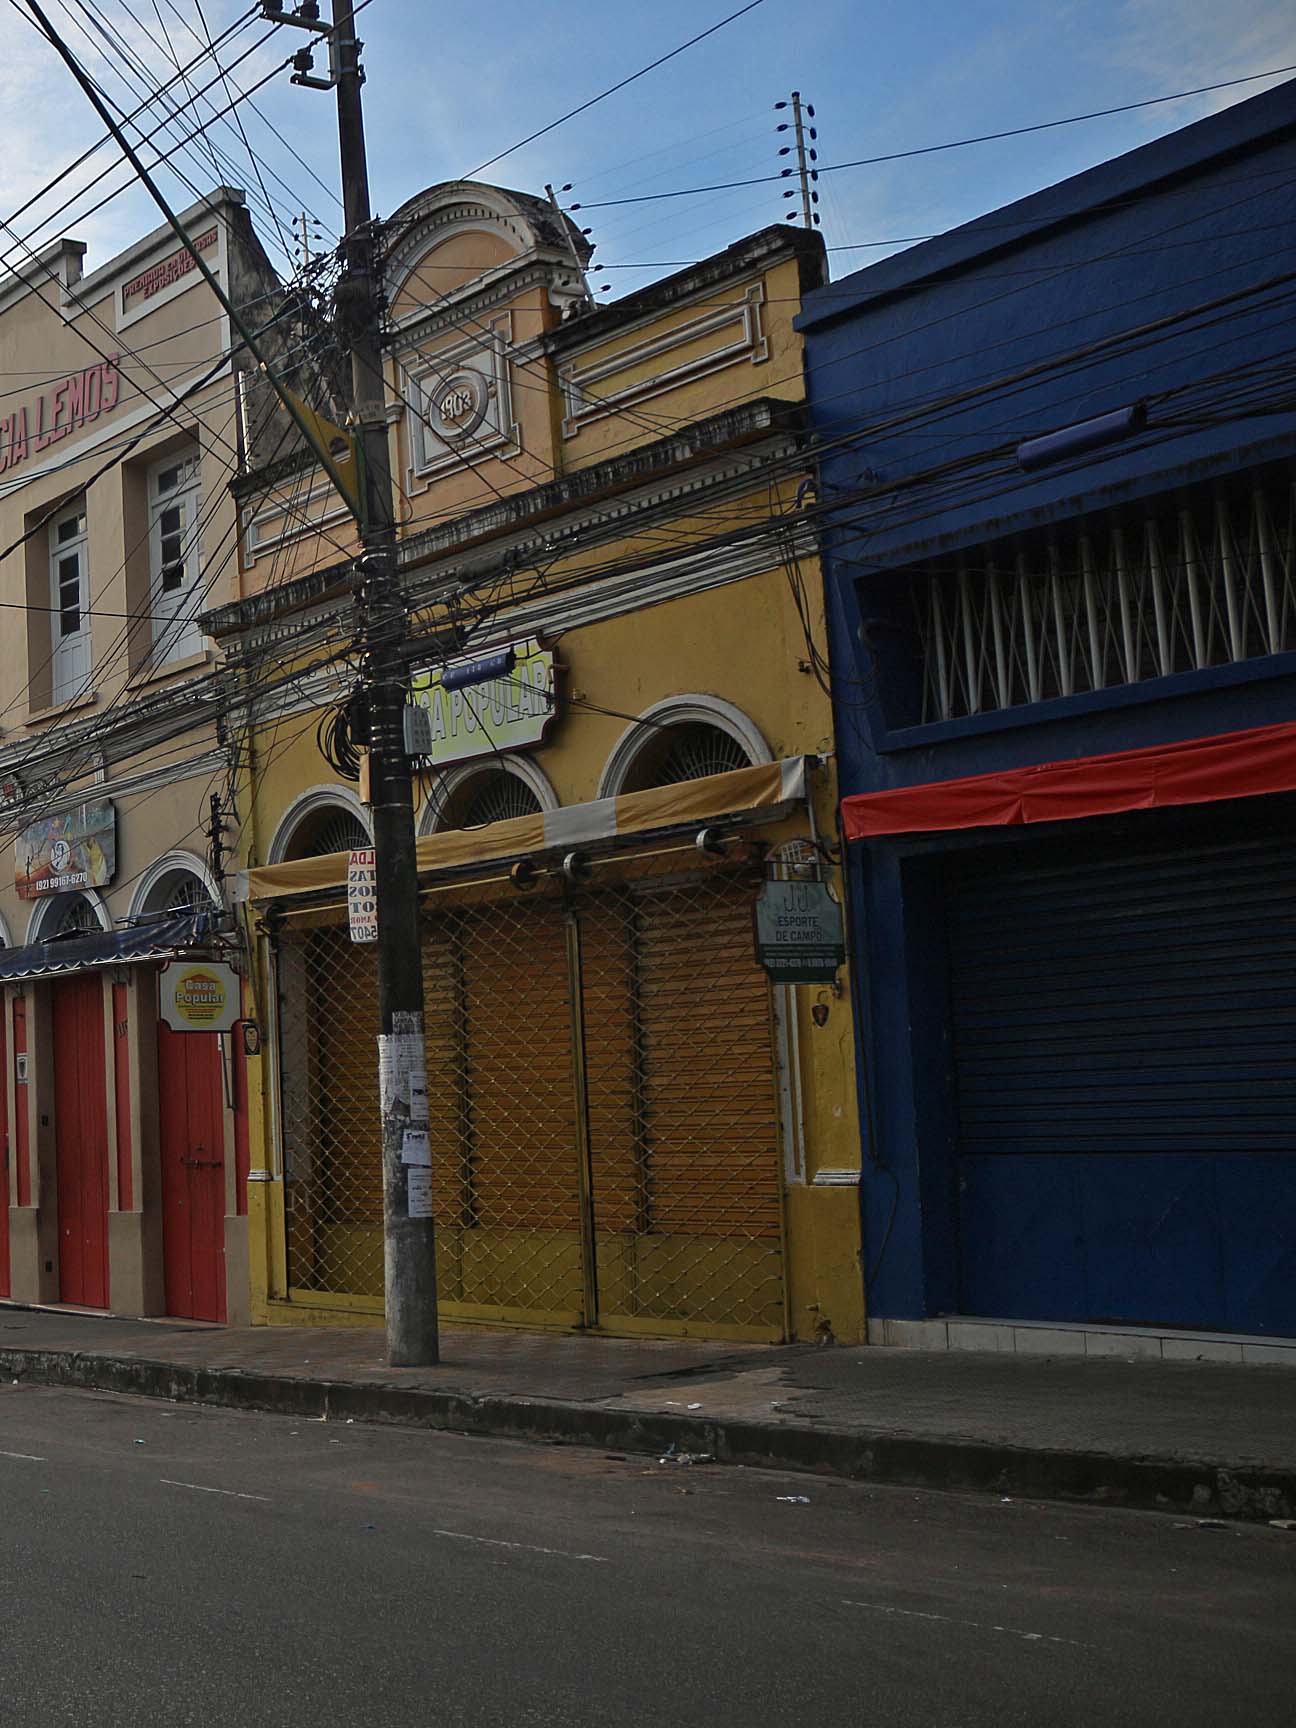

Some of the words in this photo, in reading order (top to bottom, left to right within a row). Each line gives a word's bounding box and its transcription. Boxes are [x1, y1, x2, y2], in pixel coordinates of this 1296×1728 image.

[35, 352, 120, 453] LEMOS
[450, 660, 549, 737] POPULAR
[776, 930, 789, 942] DE
[790, 929, 824, 942] CAMPO
[777, 916, 820, 928] ESPORTE
